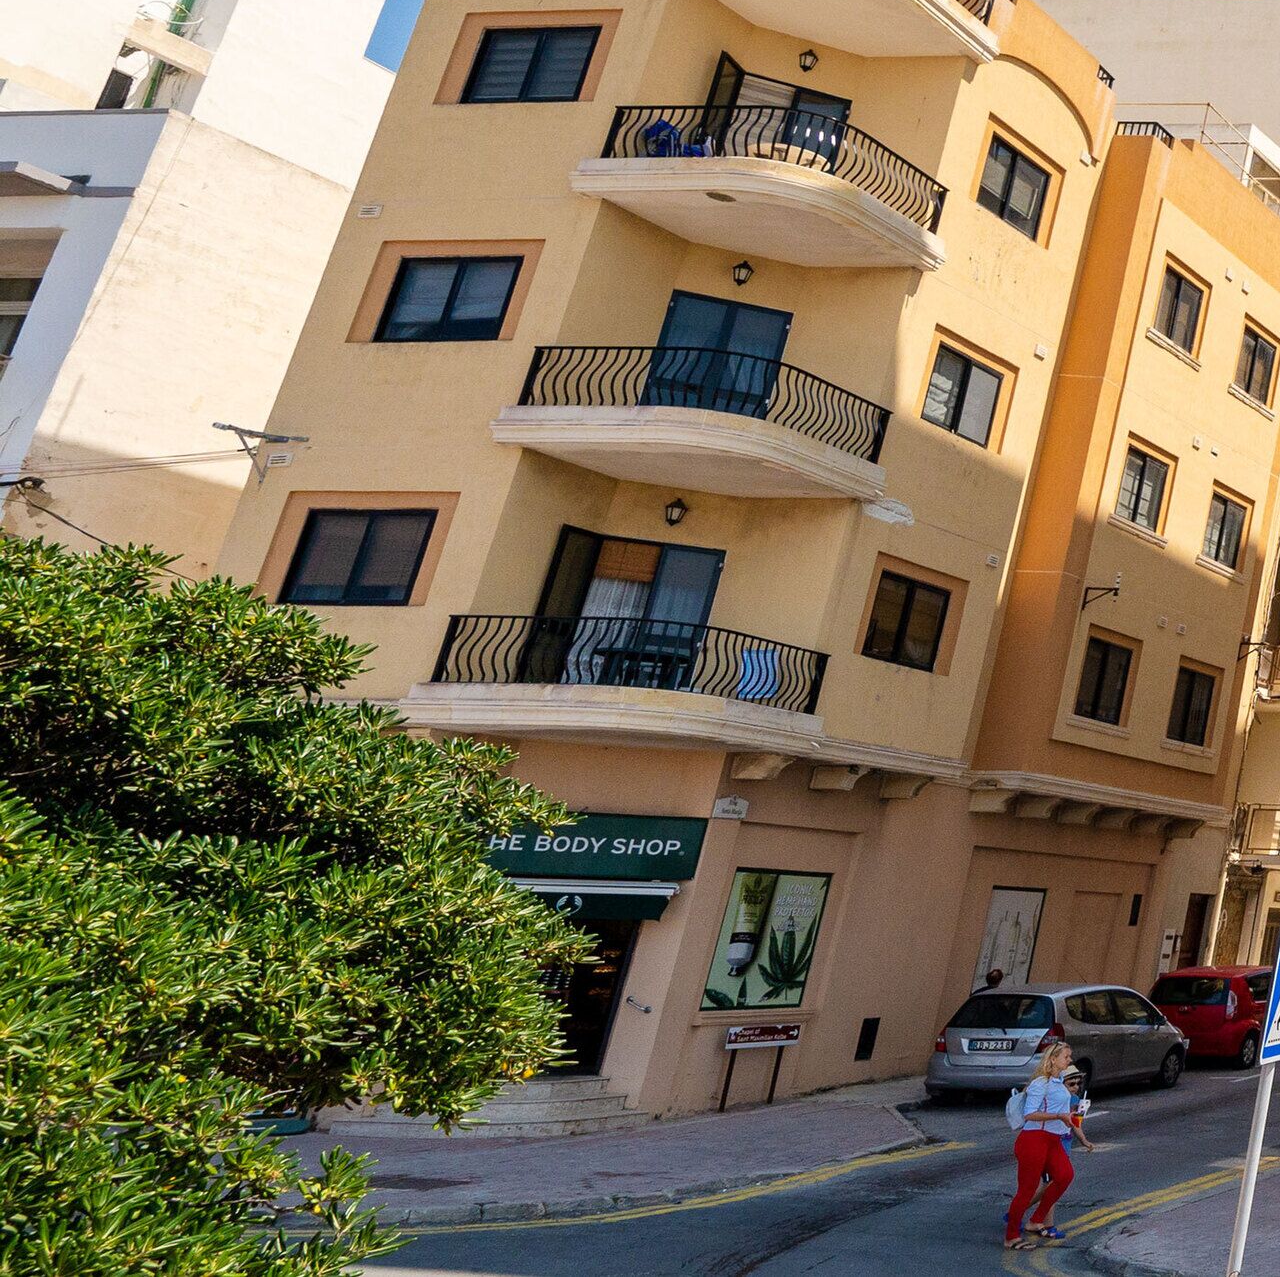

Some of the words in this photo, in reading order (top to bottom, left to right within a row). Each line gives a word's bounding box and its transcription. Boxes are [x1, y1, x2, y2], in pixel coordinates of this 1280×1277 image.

[489, 834, 526, 852] HE
[534, 835, 607, 854] BODY
[611, 838, 681, 856] SHOP
